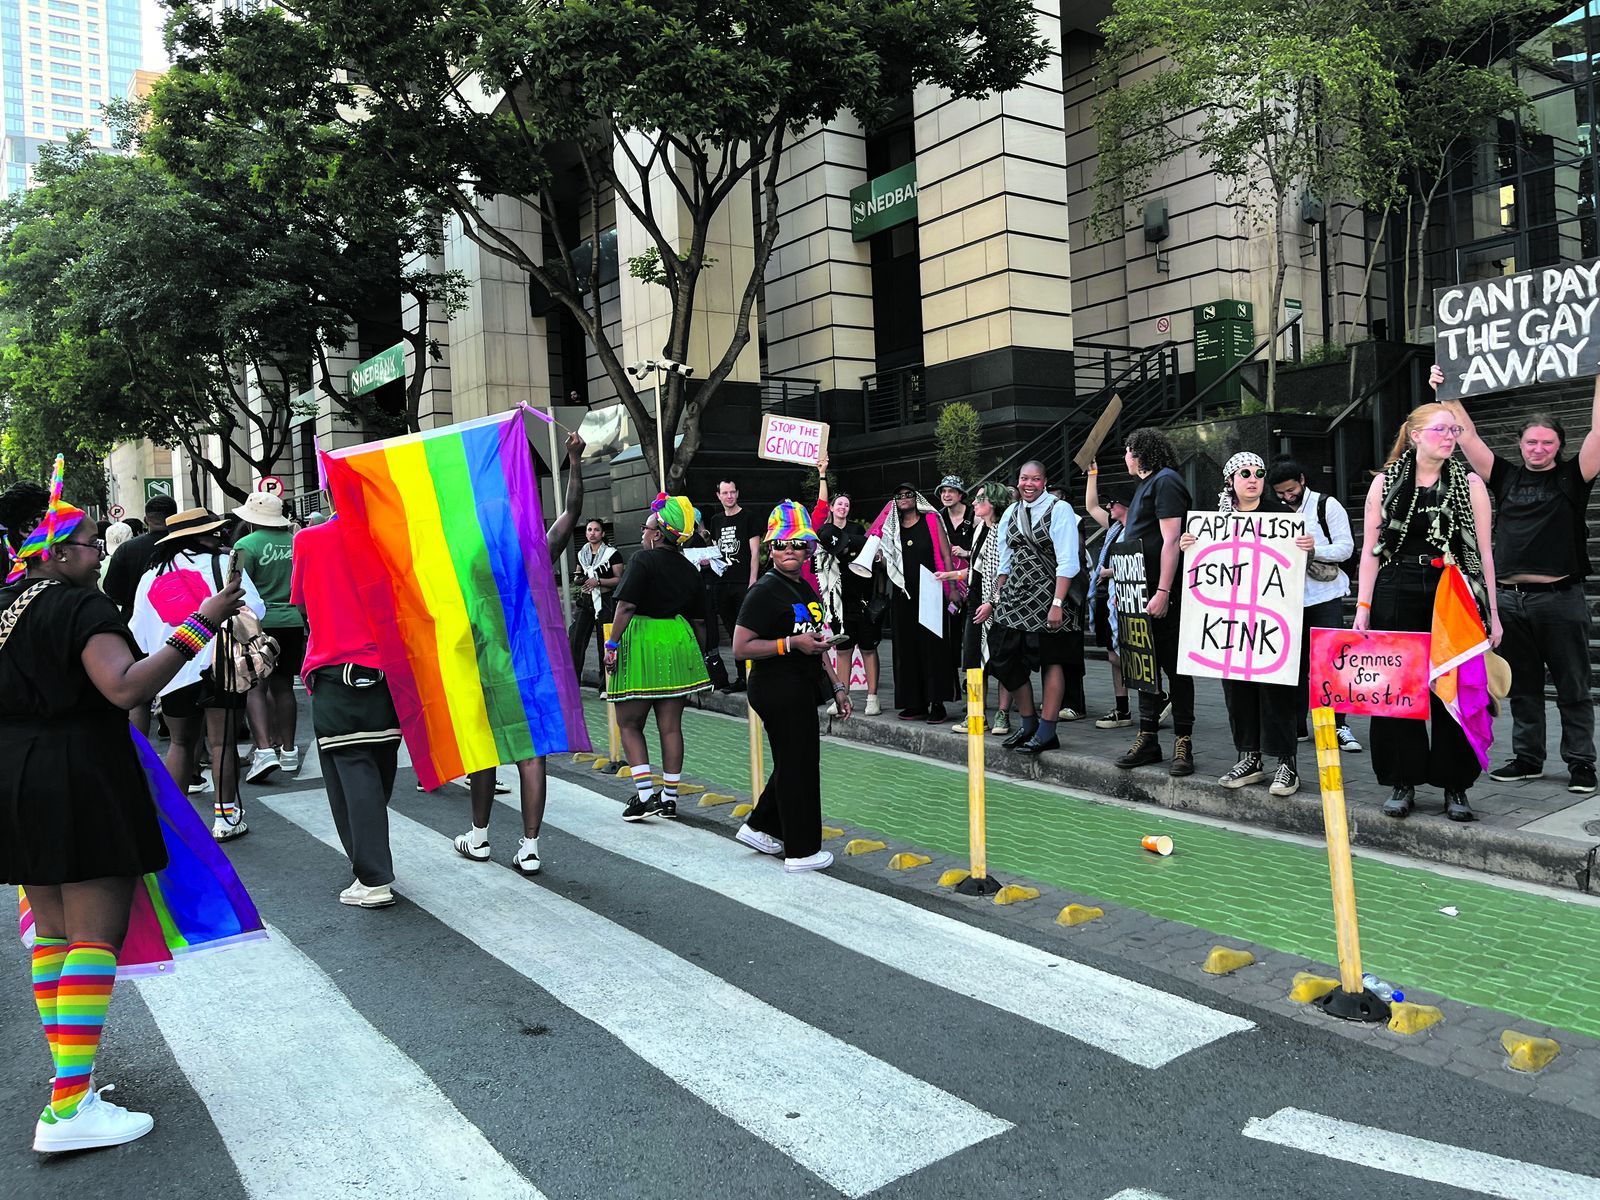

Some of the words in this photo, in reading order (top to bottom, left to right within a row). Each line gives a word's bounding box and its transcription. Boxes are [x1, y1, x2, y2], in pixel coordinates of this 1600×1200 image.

[1438, 275, 1533, 325] CANT
[1542, 260, 1600, 305] PAY
[1438, 318, 1512, 360] THE
[1518, 298, 1600, 346] GAY
[1459, 337, 1590, 394] AWAY
[770, 420, 796, 434] STOP
[799, 425, 819, 437] THE
[766, 436, 819, 459] GENOCIDE
[1187, 513, 1306, 541] CAPITALISM
[1112, 552, 1147, 582] CORPORATE
[1187, 562, 1250, 589] ISNT
[1261, 563, 1286, 598] A
[1115, 583, 1148, 614] SHAME
[1118, 614, 1152, 650] QUEER
[1201, 612, 1280, 655] KINK
[1120, 649, 1155, 685] PRIDE!
[1353, 666, 1380, 685] for
